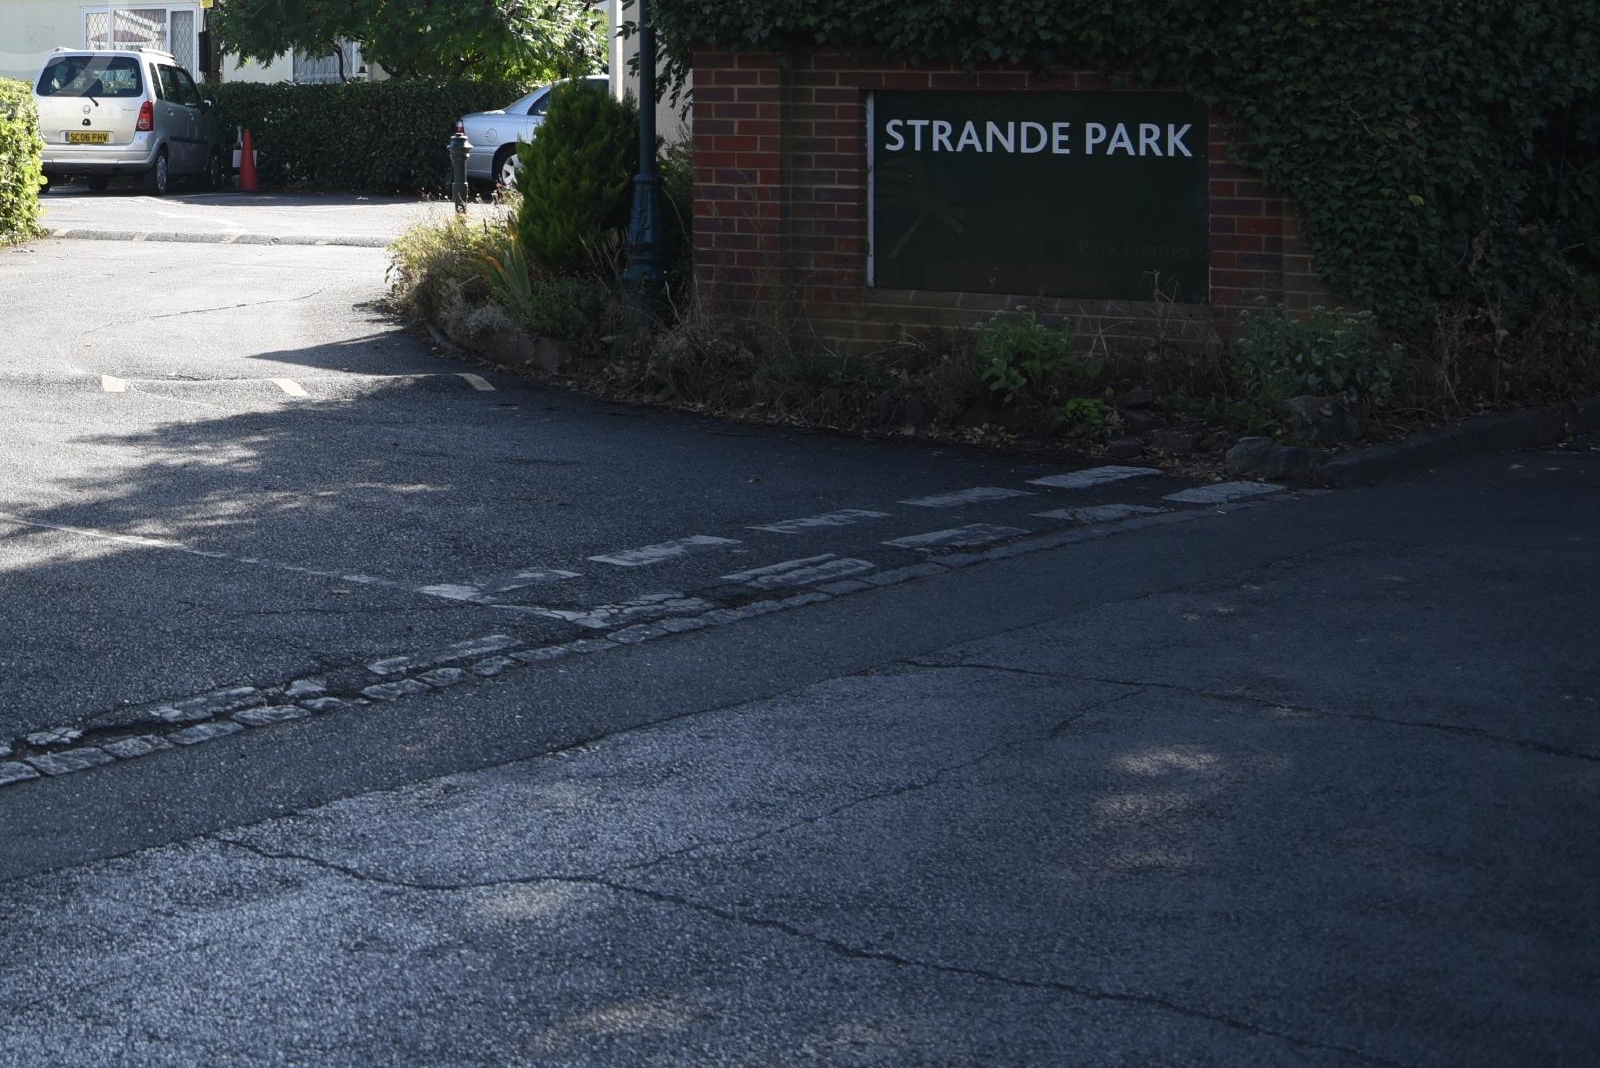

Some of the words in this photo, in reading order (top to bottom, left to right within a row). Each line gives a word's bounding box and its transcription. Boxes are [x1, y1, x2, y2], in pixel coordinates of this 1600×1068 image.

[70, 133, 90, 142] SC06
[92, 133, 108, 142] FHV
[884, 119, 1071, 154] STRANDE
[1084, 122, 1193, 157] PARK
